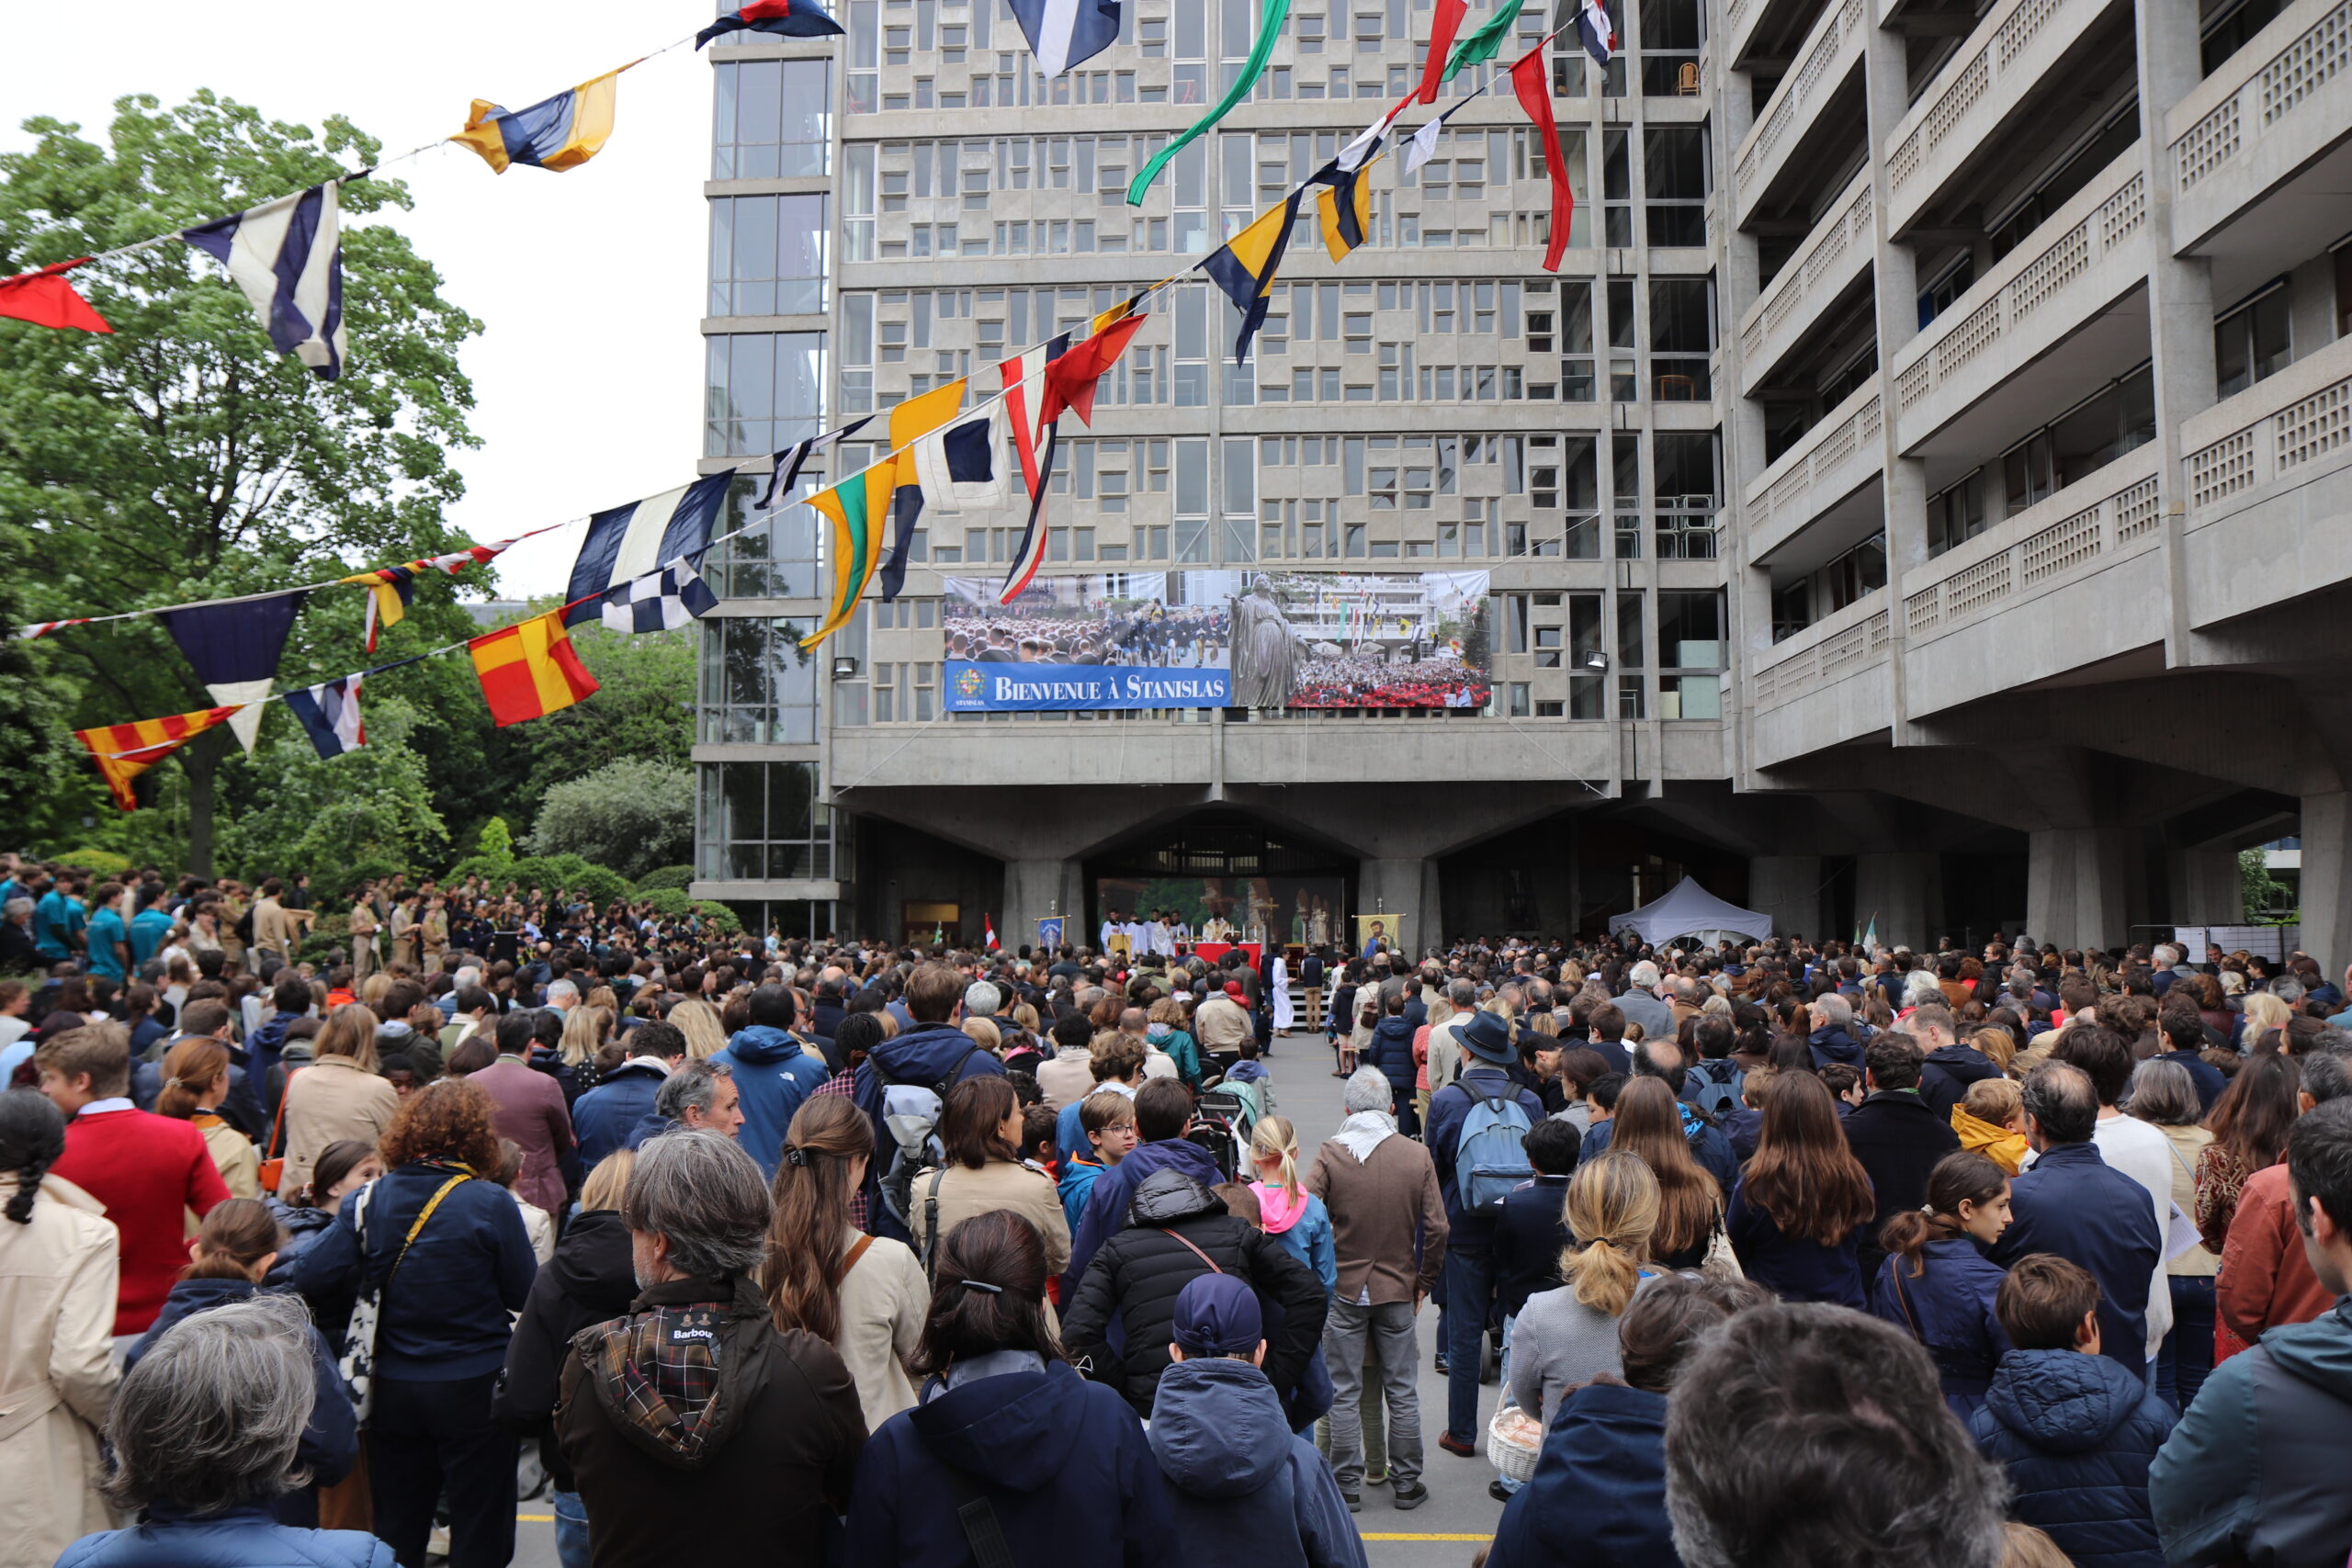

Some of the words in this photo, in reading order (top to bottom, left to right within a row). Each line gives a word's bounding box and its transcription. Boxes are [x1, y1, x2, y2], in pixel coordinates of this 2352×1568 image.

[995, 676, 1102, 701] BIENVENUE
[1107, 676, 1120, 700] À
[1126, 674, 1225, 700] STANISLAS
[673, 1328, 714, 1339] Barbour
